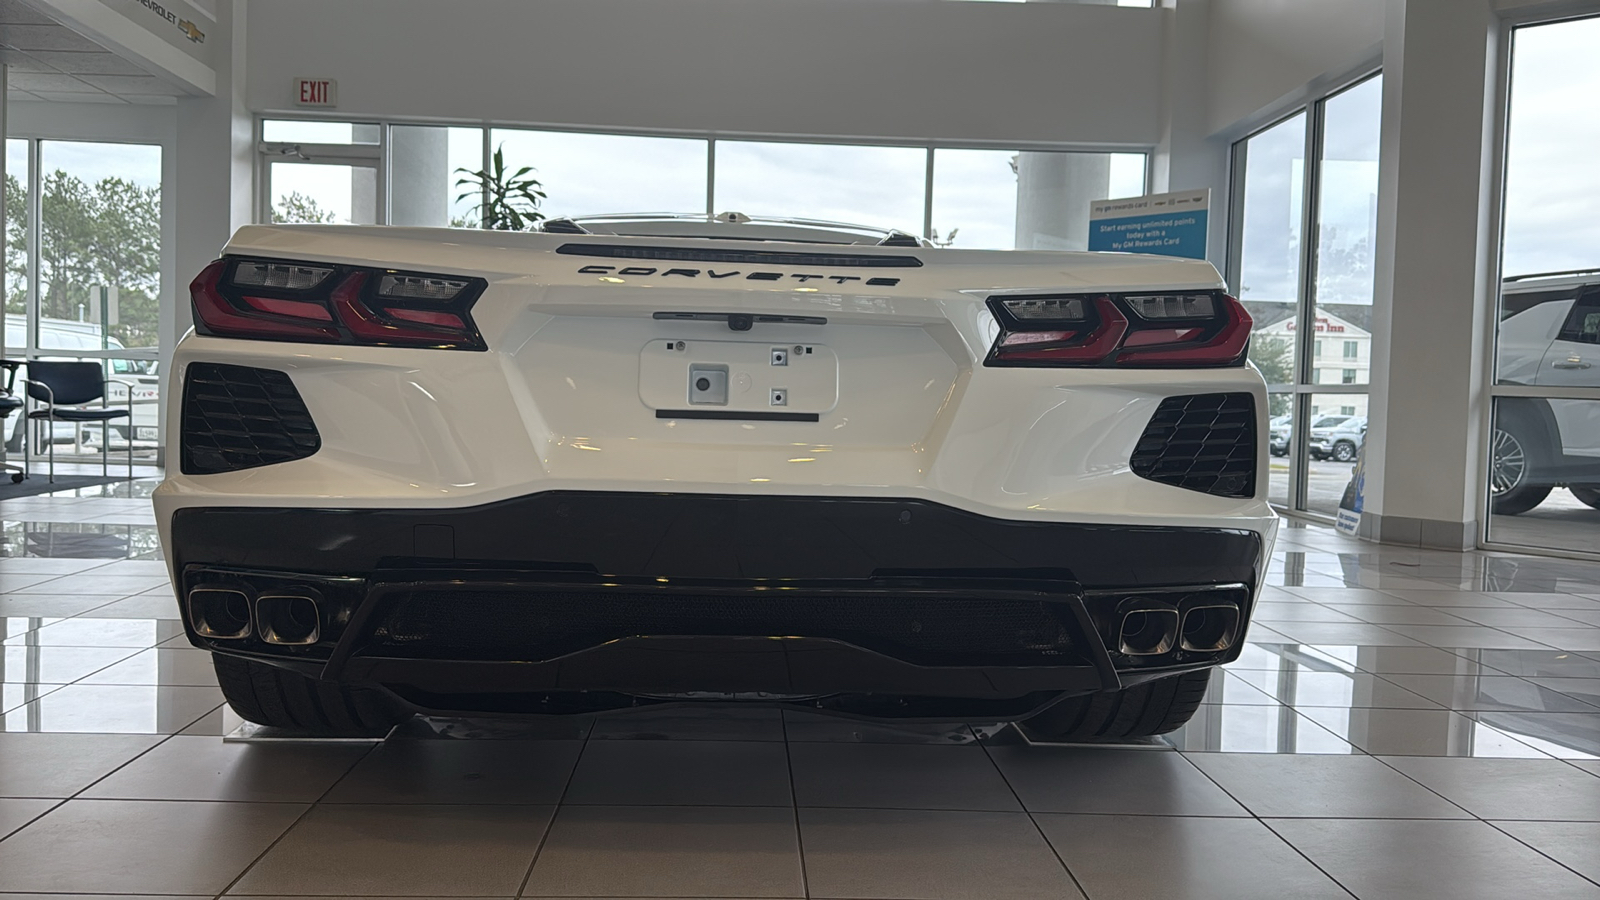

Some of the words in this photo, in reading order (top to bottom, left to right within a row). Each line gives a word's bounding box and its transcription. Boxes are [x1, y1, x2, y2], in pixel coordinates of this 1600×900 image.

[300, 80, 329, 103] EXIT
[1117, 223, 1141, 231] earning
[1142, 220, 1173, 228] unlimited
[1174, 218, 1196, 226] points
[1134, 239, 1162, 247] Rewards
[577, 265, 901, 287] CORVETTE
[1327, 323, 1345, 333] Inn
